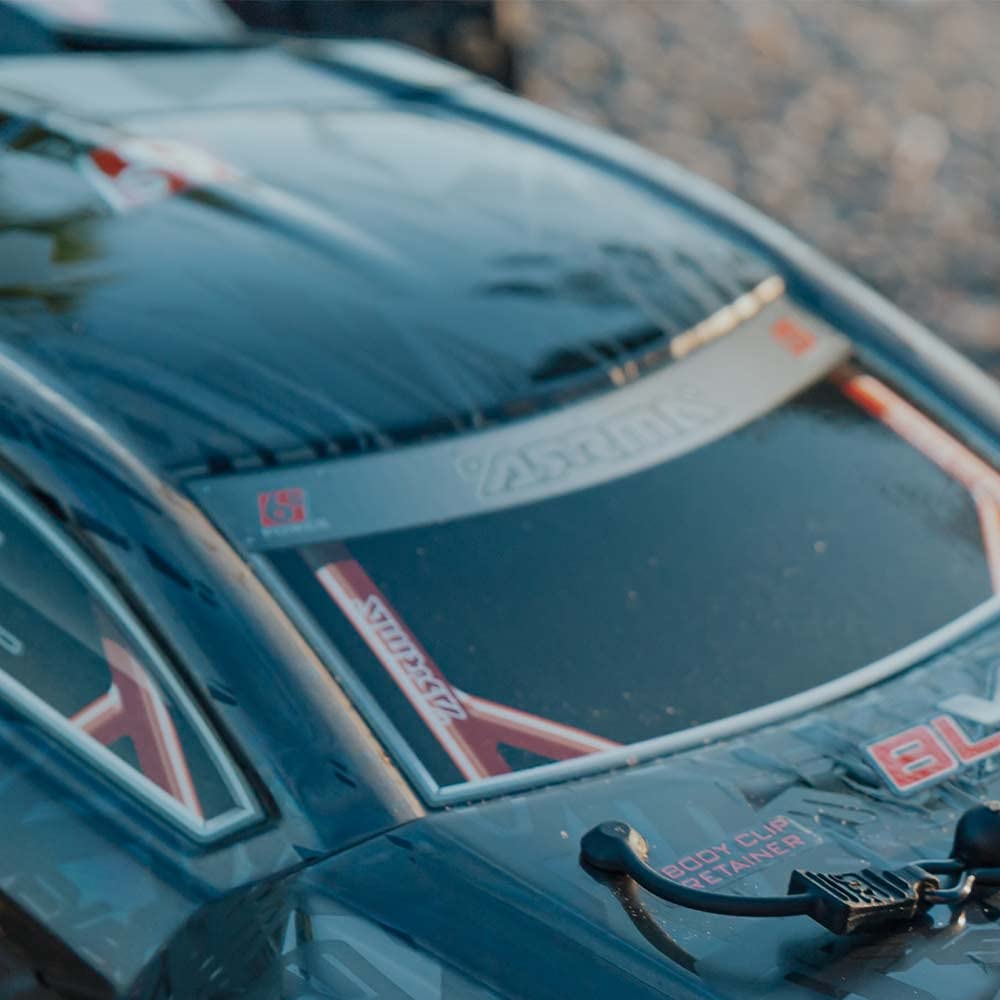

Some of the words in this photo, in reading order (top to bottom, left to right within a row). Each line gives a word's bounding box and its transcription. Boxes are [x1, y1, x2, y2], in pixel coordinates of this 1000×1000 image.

[660, 842, 731, 880] BODY
[734, 815, 790, 848] CLIP
[680, 834, 805, 890] RETAINER
